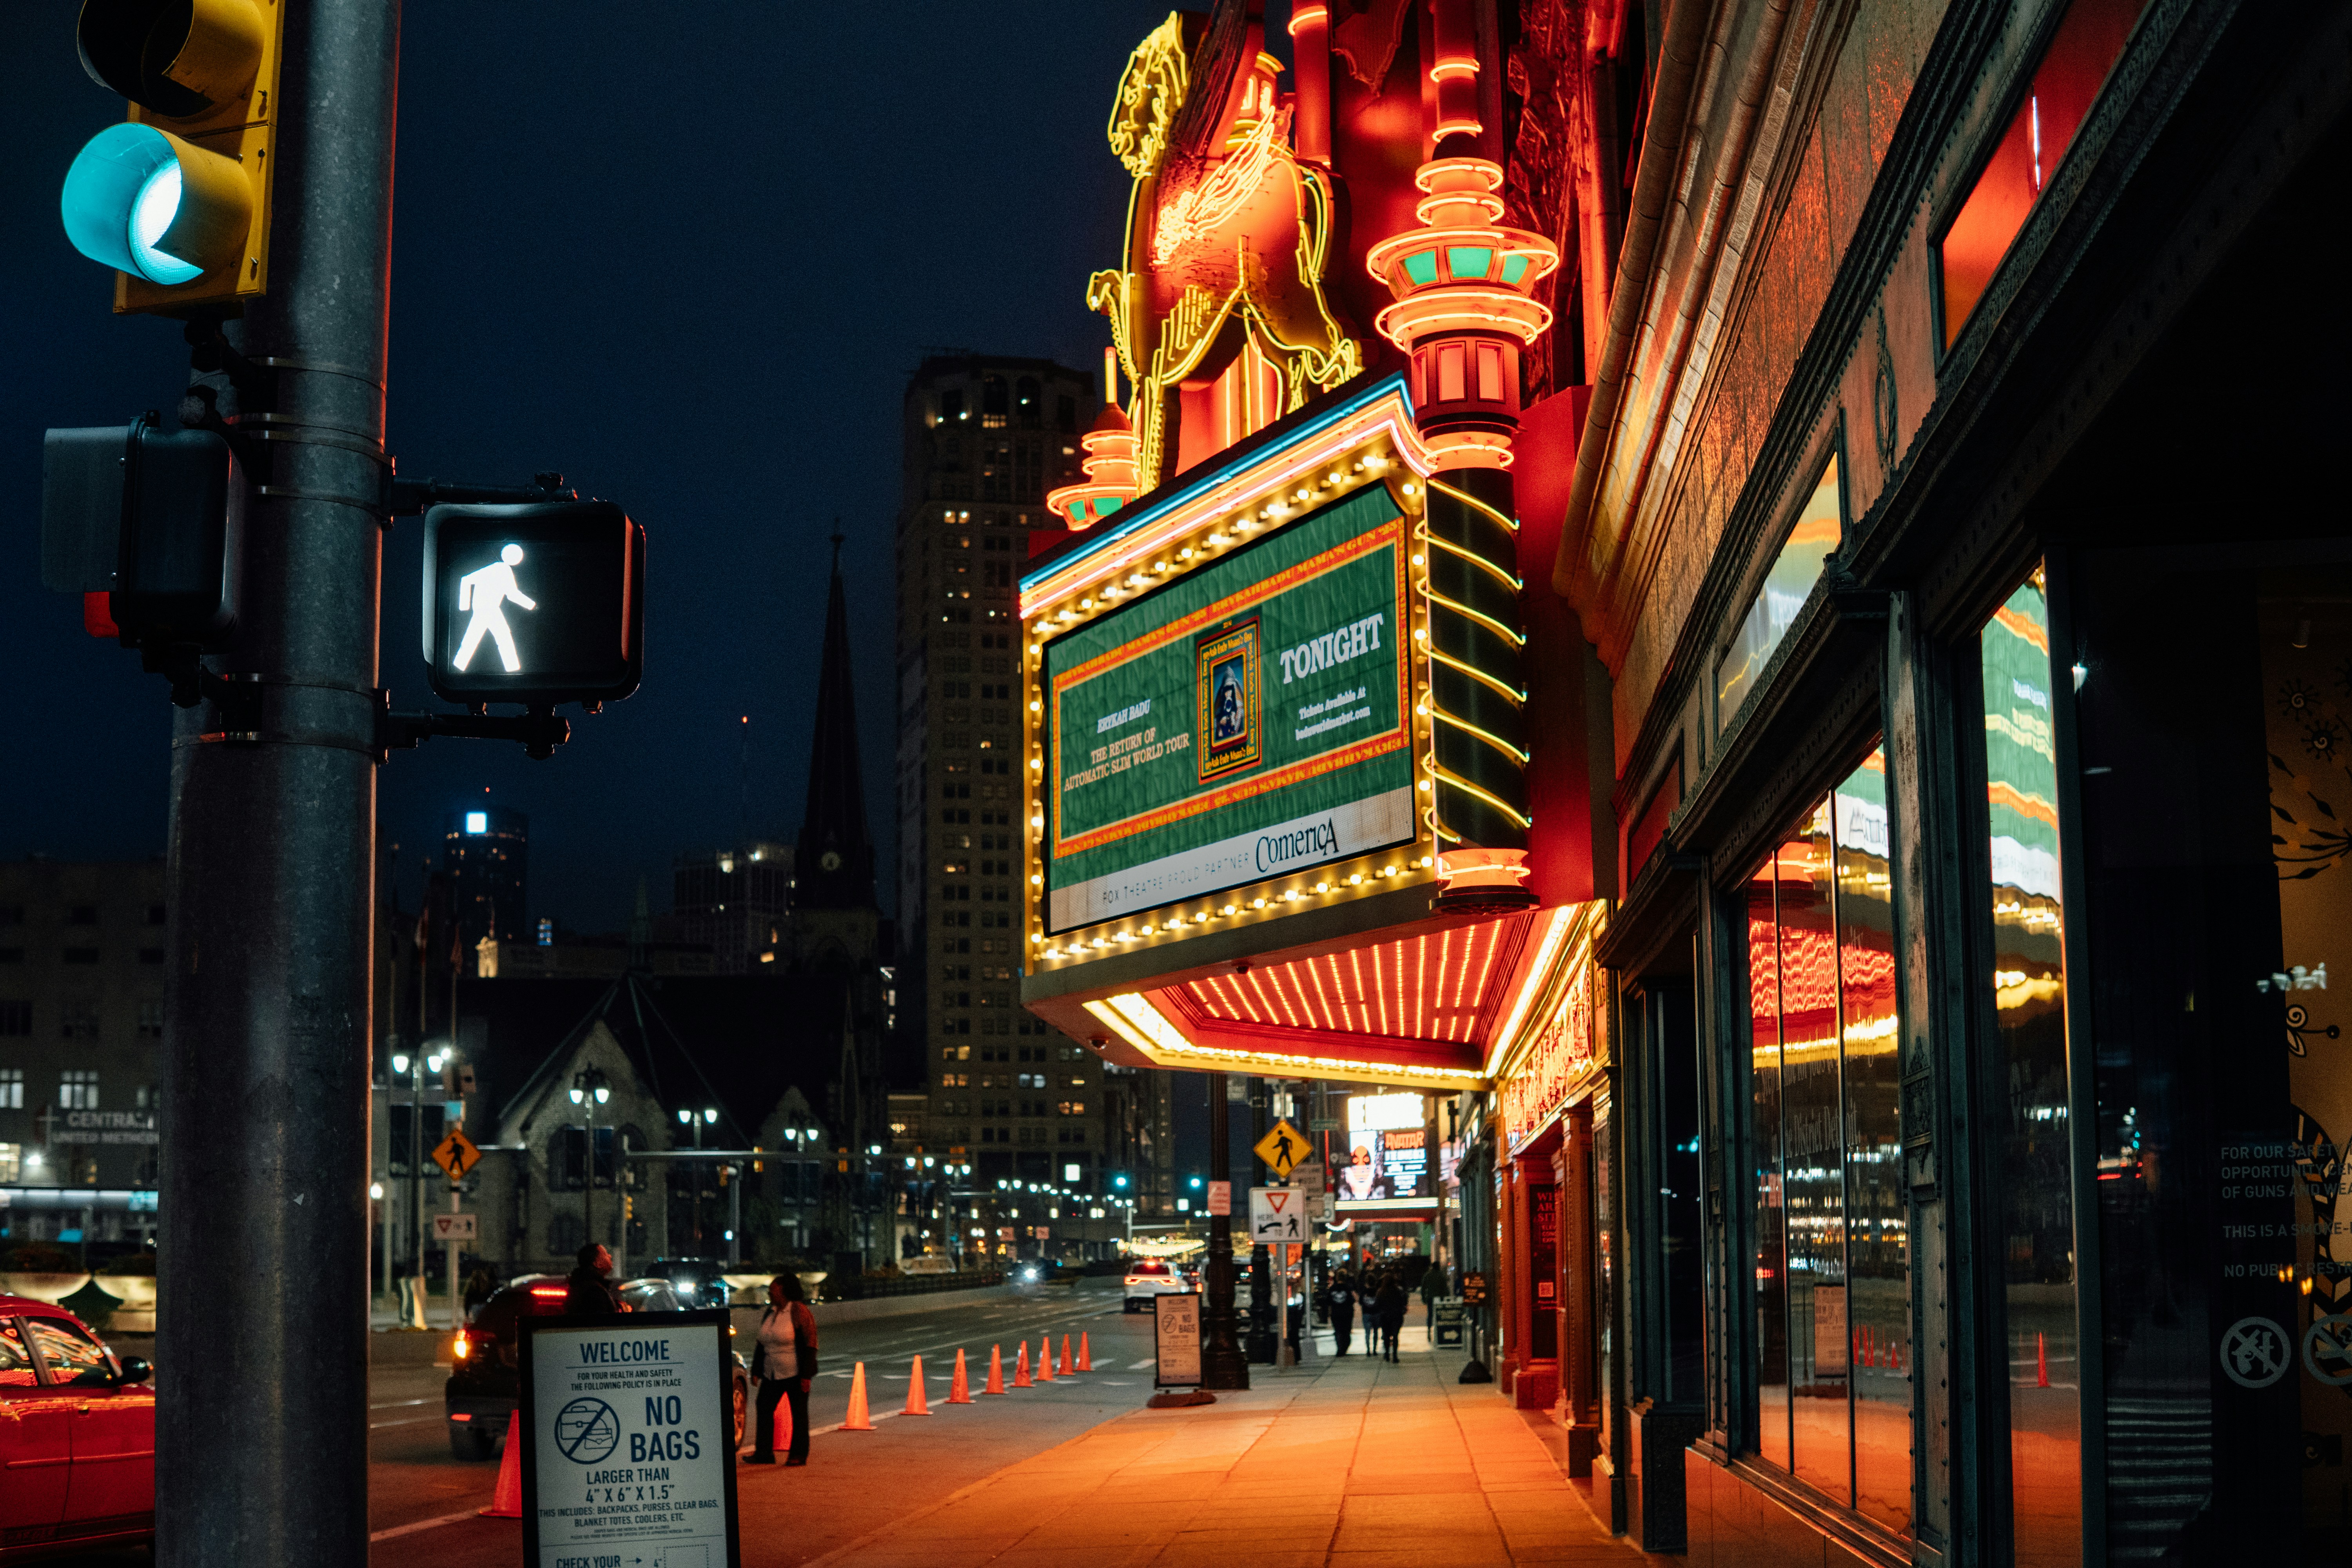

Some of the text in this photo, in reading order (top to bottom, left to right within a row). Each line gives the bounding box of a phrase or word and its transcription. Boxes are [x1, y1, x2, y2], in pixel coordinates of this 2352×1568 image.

[1280, 612, 1384, 684] TONIGHT
[1299, 686, 1366, 720] Tickets Available At
[1097, 699, 1151, 733] ERYKAH BADU
[1091, 728, 1156, 764] THE RETURN OF
[1064, 733, 1189, 791] AUTOMATIC SLIM WORLD TOUR
[1103, 852, 1249, 904] FOX THEATRE PROUD PARTNER
[1794, 1109, 1822, 1156] District
[1825, 1097, 1861, 1149] Detoit.
[1385, 1131, 1425, 1150] AVATAR
[2221, 1144, 2339, 1160] FOR OUR SAFETY
[2221, 1164, 2323, 1179] OPPORTUNITY
[2222, 1186, 2240, 1199] OF
[2245, 1185, 2285, 1198] GUNS
[2289, 1183, 2320, 1197] AND
[2223, 1225, 2256, 1238] THIS
[2261, 1225, 2273, 1237] IS
[2278, 1225, 2288, 1237] A
[2224, 1265, 2244, 1277] NO
[580, 1340, 670, 1363] WELCOME
[578, 1372, 590, 1380] FOR
[592, 1371, 608, 1379] YOUR
[610, 1370, 633, 1379] HEALTH
[650, 1369, 673, 1377] SAFETY
[584, 1382, 621, 1390] FOLLOWING
[622, 1381, 644, 1389] POLICY
[662, 1378, 681, 1387] PLACE
[646, 1396, 681, 1426] NO
[631, 1430, 700, 1462] BAGS
[587, 1467, 670, 1485] LARGER THAN
[605, 1489, 613, 1503] X
[636, 1487, 644, 1501] X
[539, 1509, 556, 1518] THIS
[557, 1507, 595, 1516] INCLUDES:
[575, 1517, 607, 1527] BLANKET
[670, 1513, 685, 1521] ETC.
[556, 1555, 621, 1568] CHECK YOUR
